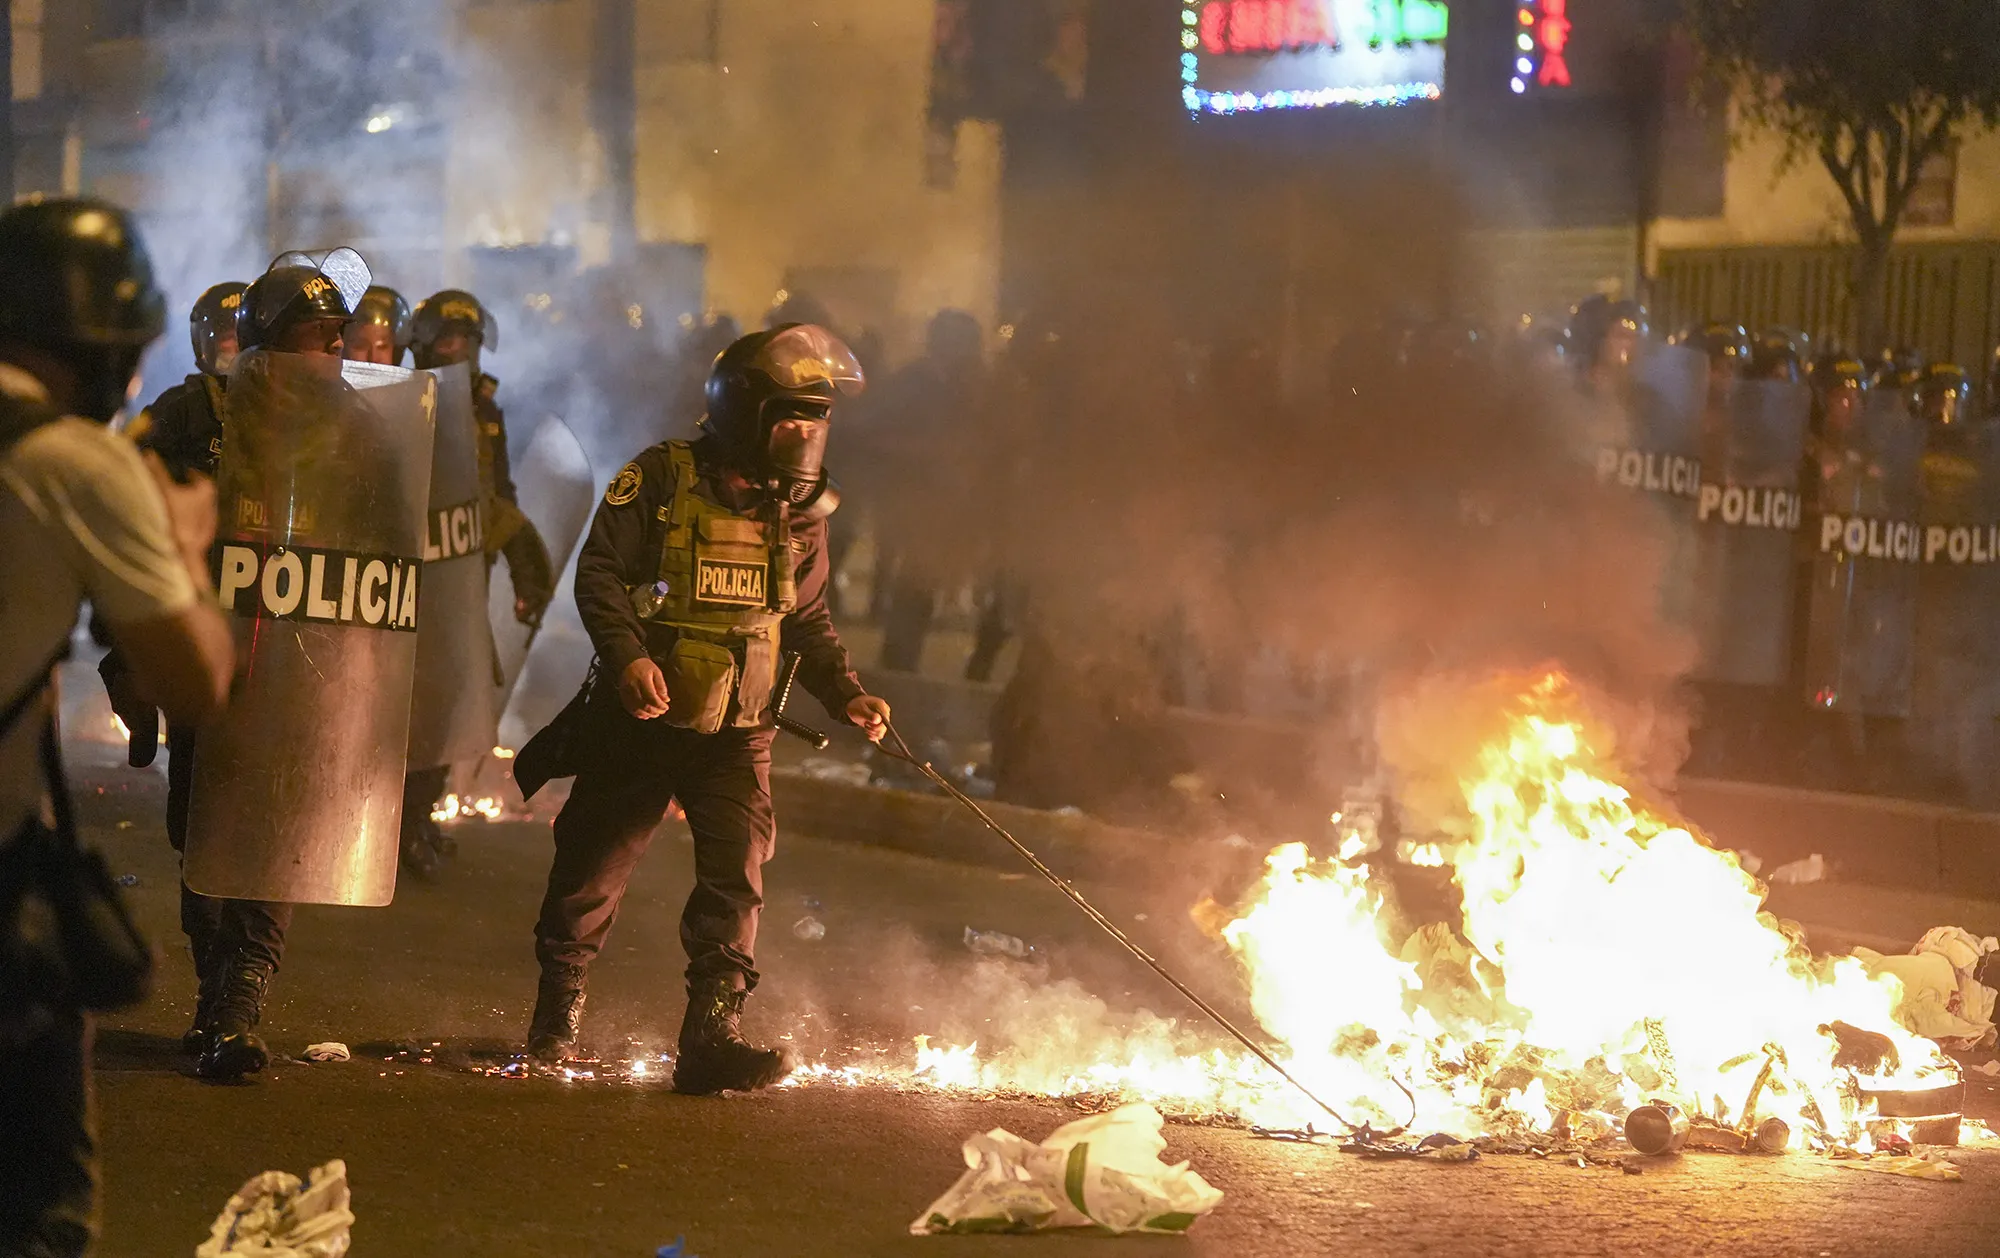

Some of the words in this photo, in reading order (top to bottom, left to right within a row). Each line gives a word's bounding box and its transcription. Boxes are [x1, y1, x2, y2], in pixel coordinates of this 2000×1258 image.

[1926, 525, 2000, 564] POLI
[219, 546, 416, 628] POLICIA
[701, 565, 762, 599] POLICIA
